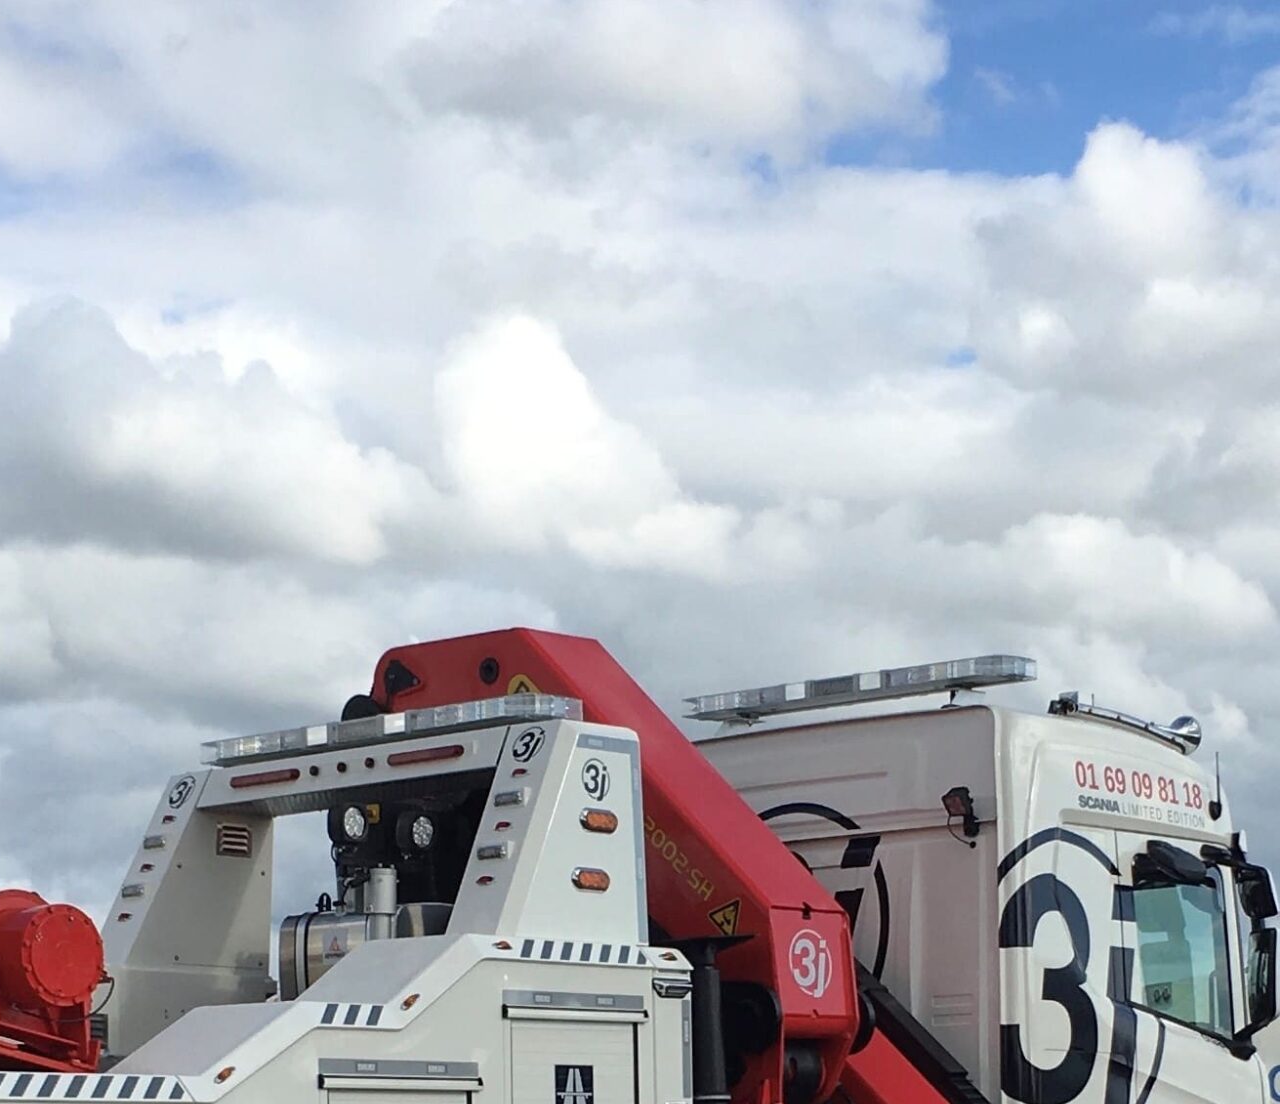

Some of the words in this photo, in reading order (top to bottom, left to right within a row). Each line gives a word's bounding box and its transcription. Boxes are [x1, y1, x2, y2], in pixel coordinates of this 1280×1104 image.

[584, 764, 608, 801] 3j
[1075, 760, 1099, 791] 01
[1104, 765, 1127, 795] 69
[1131, 770, 1153, 800] 09
[1157, 776, 1180, 805] 81
[1182, 781, 1203, 810] 18
[1078, 794, 1120, 813] SCANIA
[1122, 803, 1162, 821] LIMITED
[1167, 809, 1205, 828] EDITION
[793, 938, 826, 998] 3j
